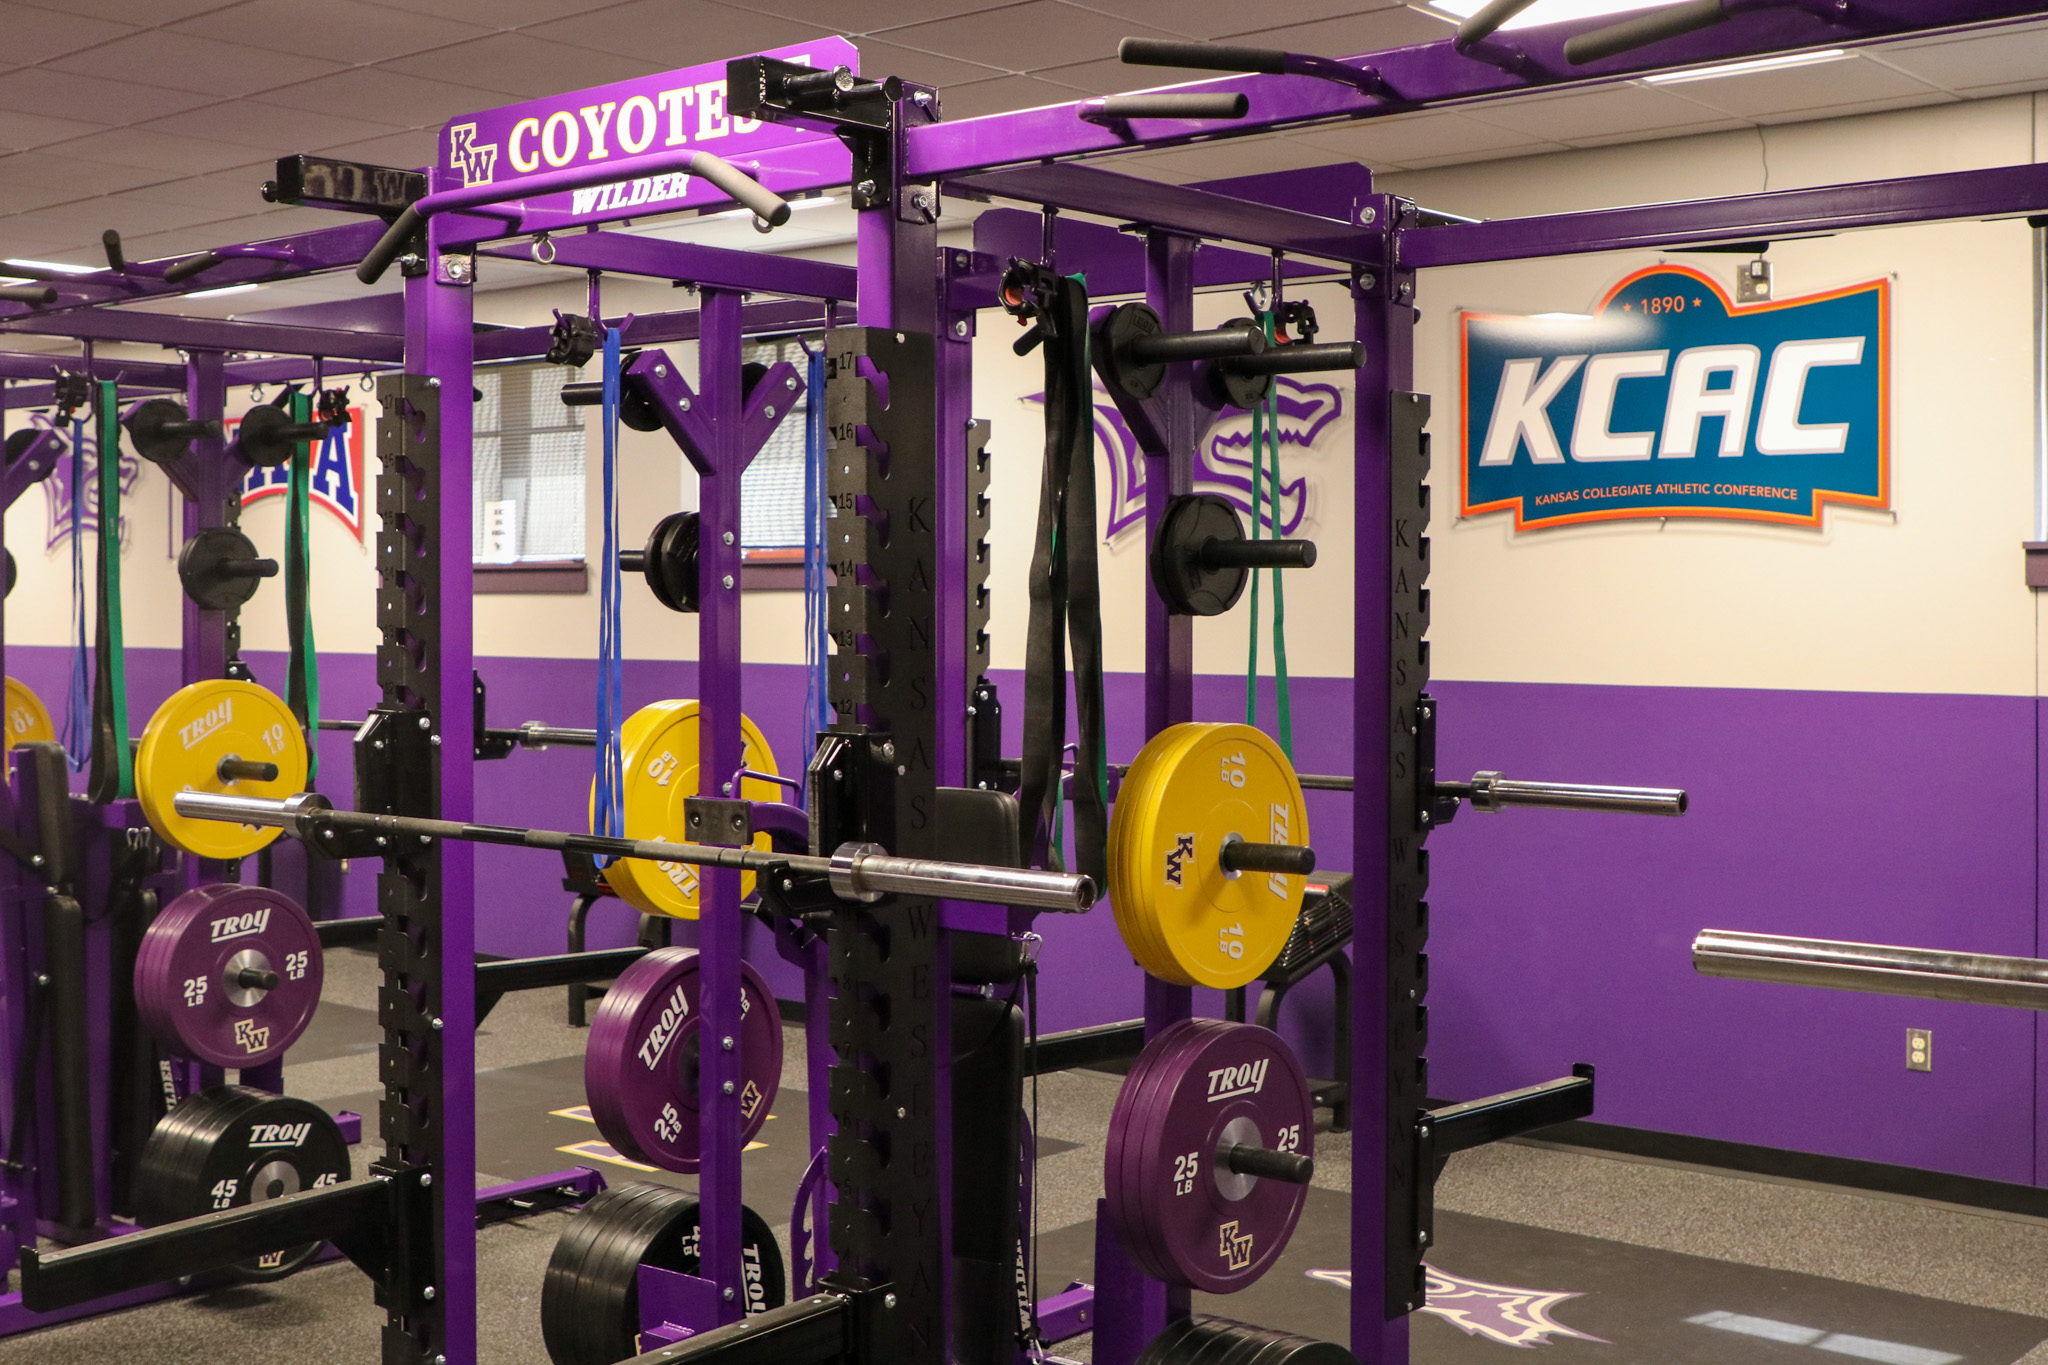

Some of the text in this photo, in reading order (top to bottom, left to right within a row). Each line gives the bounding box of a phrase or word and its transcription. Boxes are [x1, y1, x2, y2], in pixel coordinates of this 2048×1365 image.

[451, 123, 498, 188] KW
[571, 172, 690, 217] WILDER
[1640, 295, 1685, 315] 1890
[839, 354, 853, 370] 17
[1478, 336, 1866, 467] KCAC
[839, 423, 853, 440] 16
[839, 493, 853, 510] 15
[1535, 483, 1798, 506] KANSAS COLLEGIATE ATHLETIC CONFERENCE
[839, 561, 853, 578] 14
[839, 630, 853, 647] 13
[178, 698, 232, 749] TROY
[261, 723, 284, 748] 10
[269, 740, 284, 756] LB
[662, 751, 679, 769] LB
[647, 763, 671, 786] 10
[1220, 757, 1230, 783] LB
[1228, 751, 1246, 788] 10
[1164, 832, 1196, 889] KW
[210, 908, 271, 943] TROY
[1219, 928, 1229, 954] LB
[1227, 922, 1244, 960] 10
[285, 950, 308, 972] 25
[289, 968, 305, 980] LB
[183, 975, 208, 998] 25
[187, 994, 204, 1008] LB
[234, 1018, 270, 1054] KW
[637, 985, 689, 1070] TROY
[1207, 1059, 1269, 1102] TROY
[654, 1102, 678, 1141] 25
[667, 1120, 682, 1144] LB
[248, 1123, 312, 1148] TROY
[1277, 1124, 1300, 1152] 25
[1173, 1151, 1199, 1182] 25
[211, 1179, 239, 1198] 45
[1176, 1180, 1193, 1196] LB
[213, 1198, 230, 1209] LB
[682, 1235, 693, 1256] LB
[1220, 1220, 1253, 1271] KW
